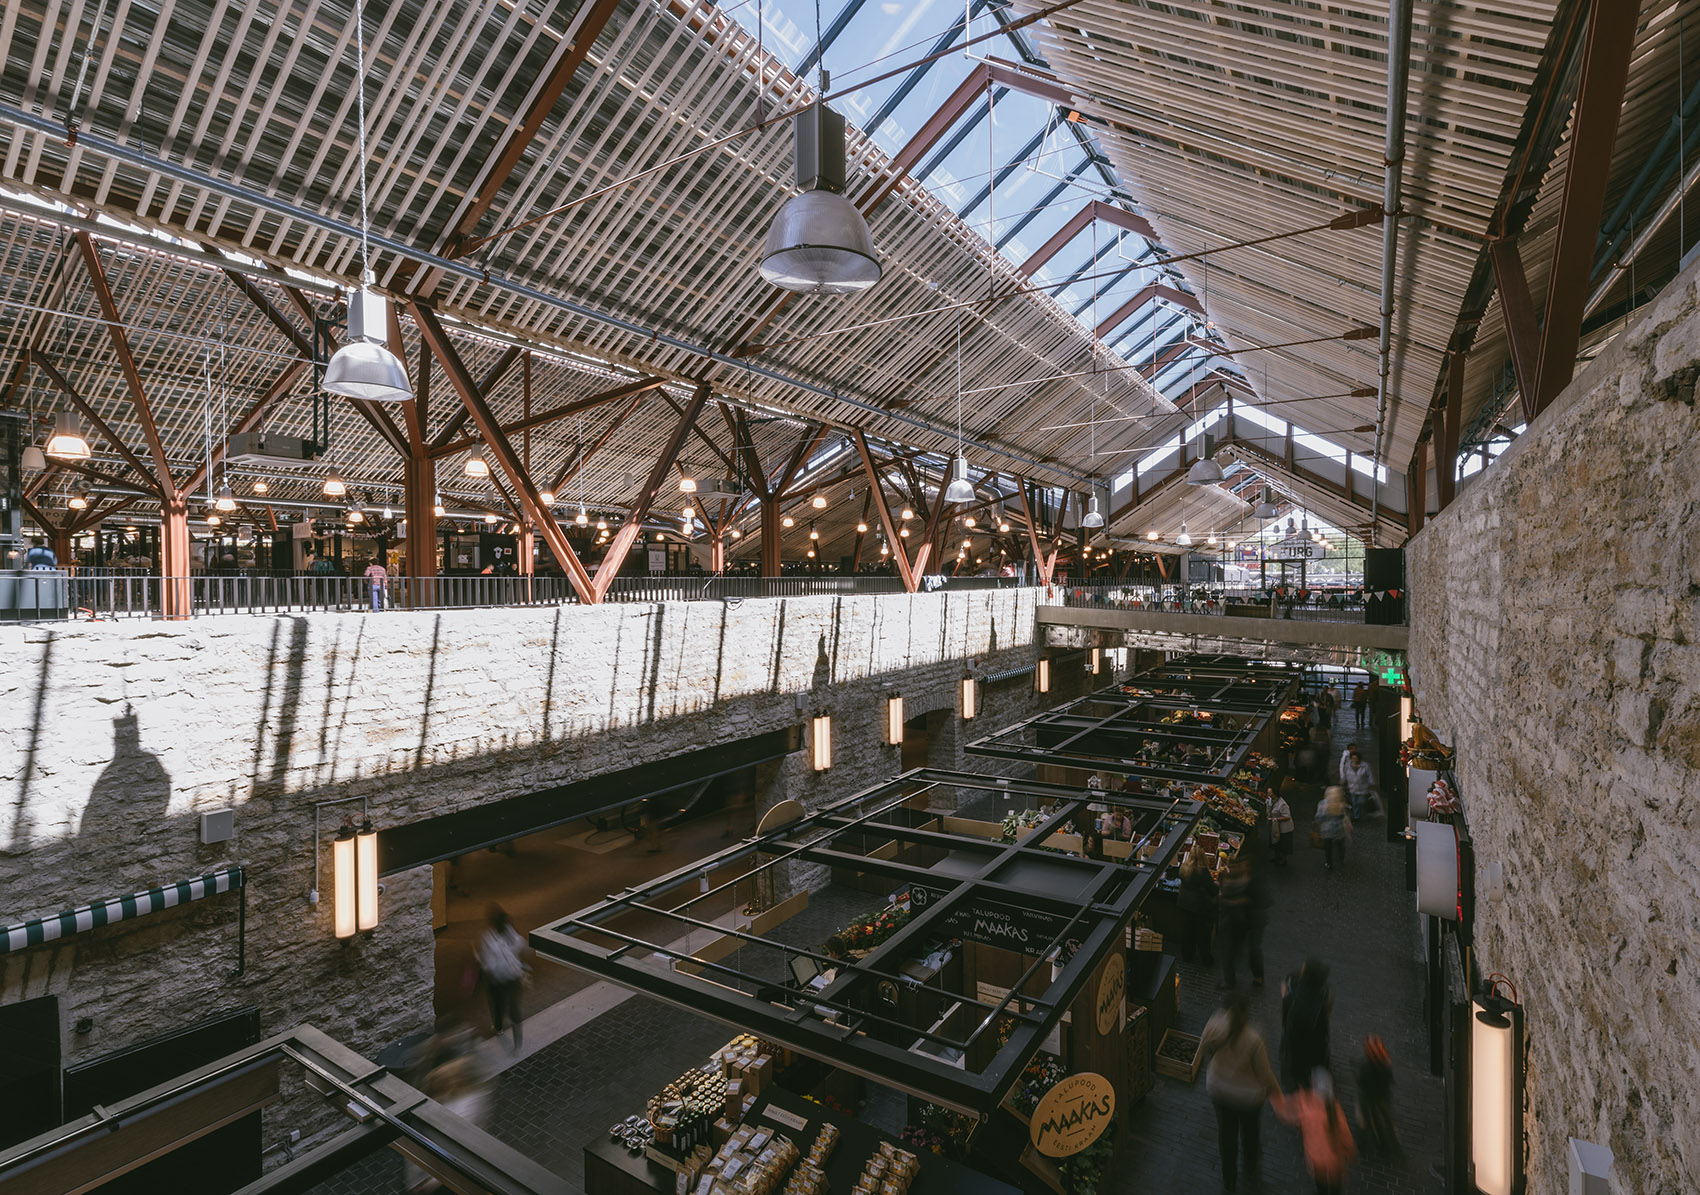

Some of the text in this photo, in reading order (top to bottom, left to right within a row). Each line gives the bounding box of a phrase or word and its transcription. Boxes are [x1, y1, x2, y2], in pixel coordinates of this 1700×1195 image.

[972, 907, 1011, 922] TALUPOOD
[974, 918, 1029, 943] MAAKAS
[1098, 969, 1124, 1028] MAAKAS
[1054, 1079, 1097, 1104] TALUPOOD
[1037, 1094, 1111, 1147] MAAKAS
[1053, 1124, 1097, 1151] EESTI KRAAM
